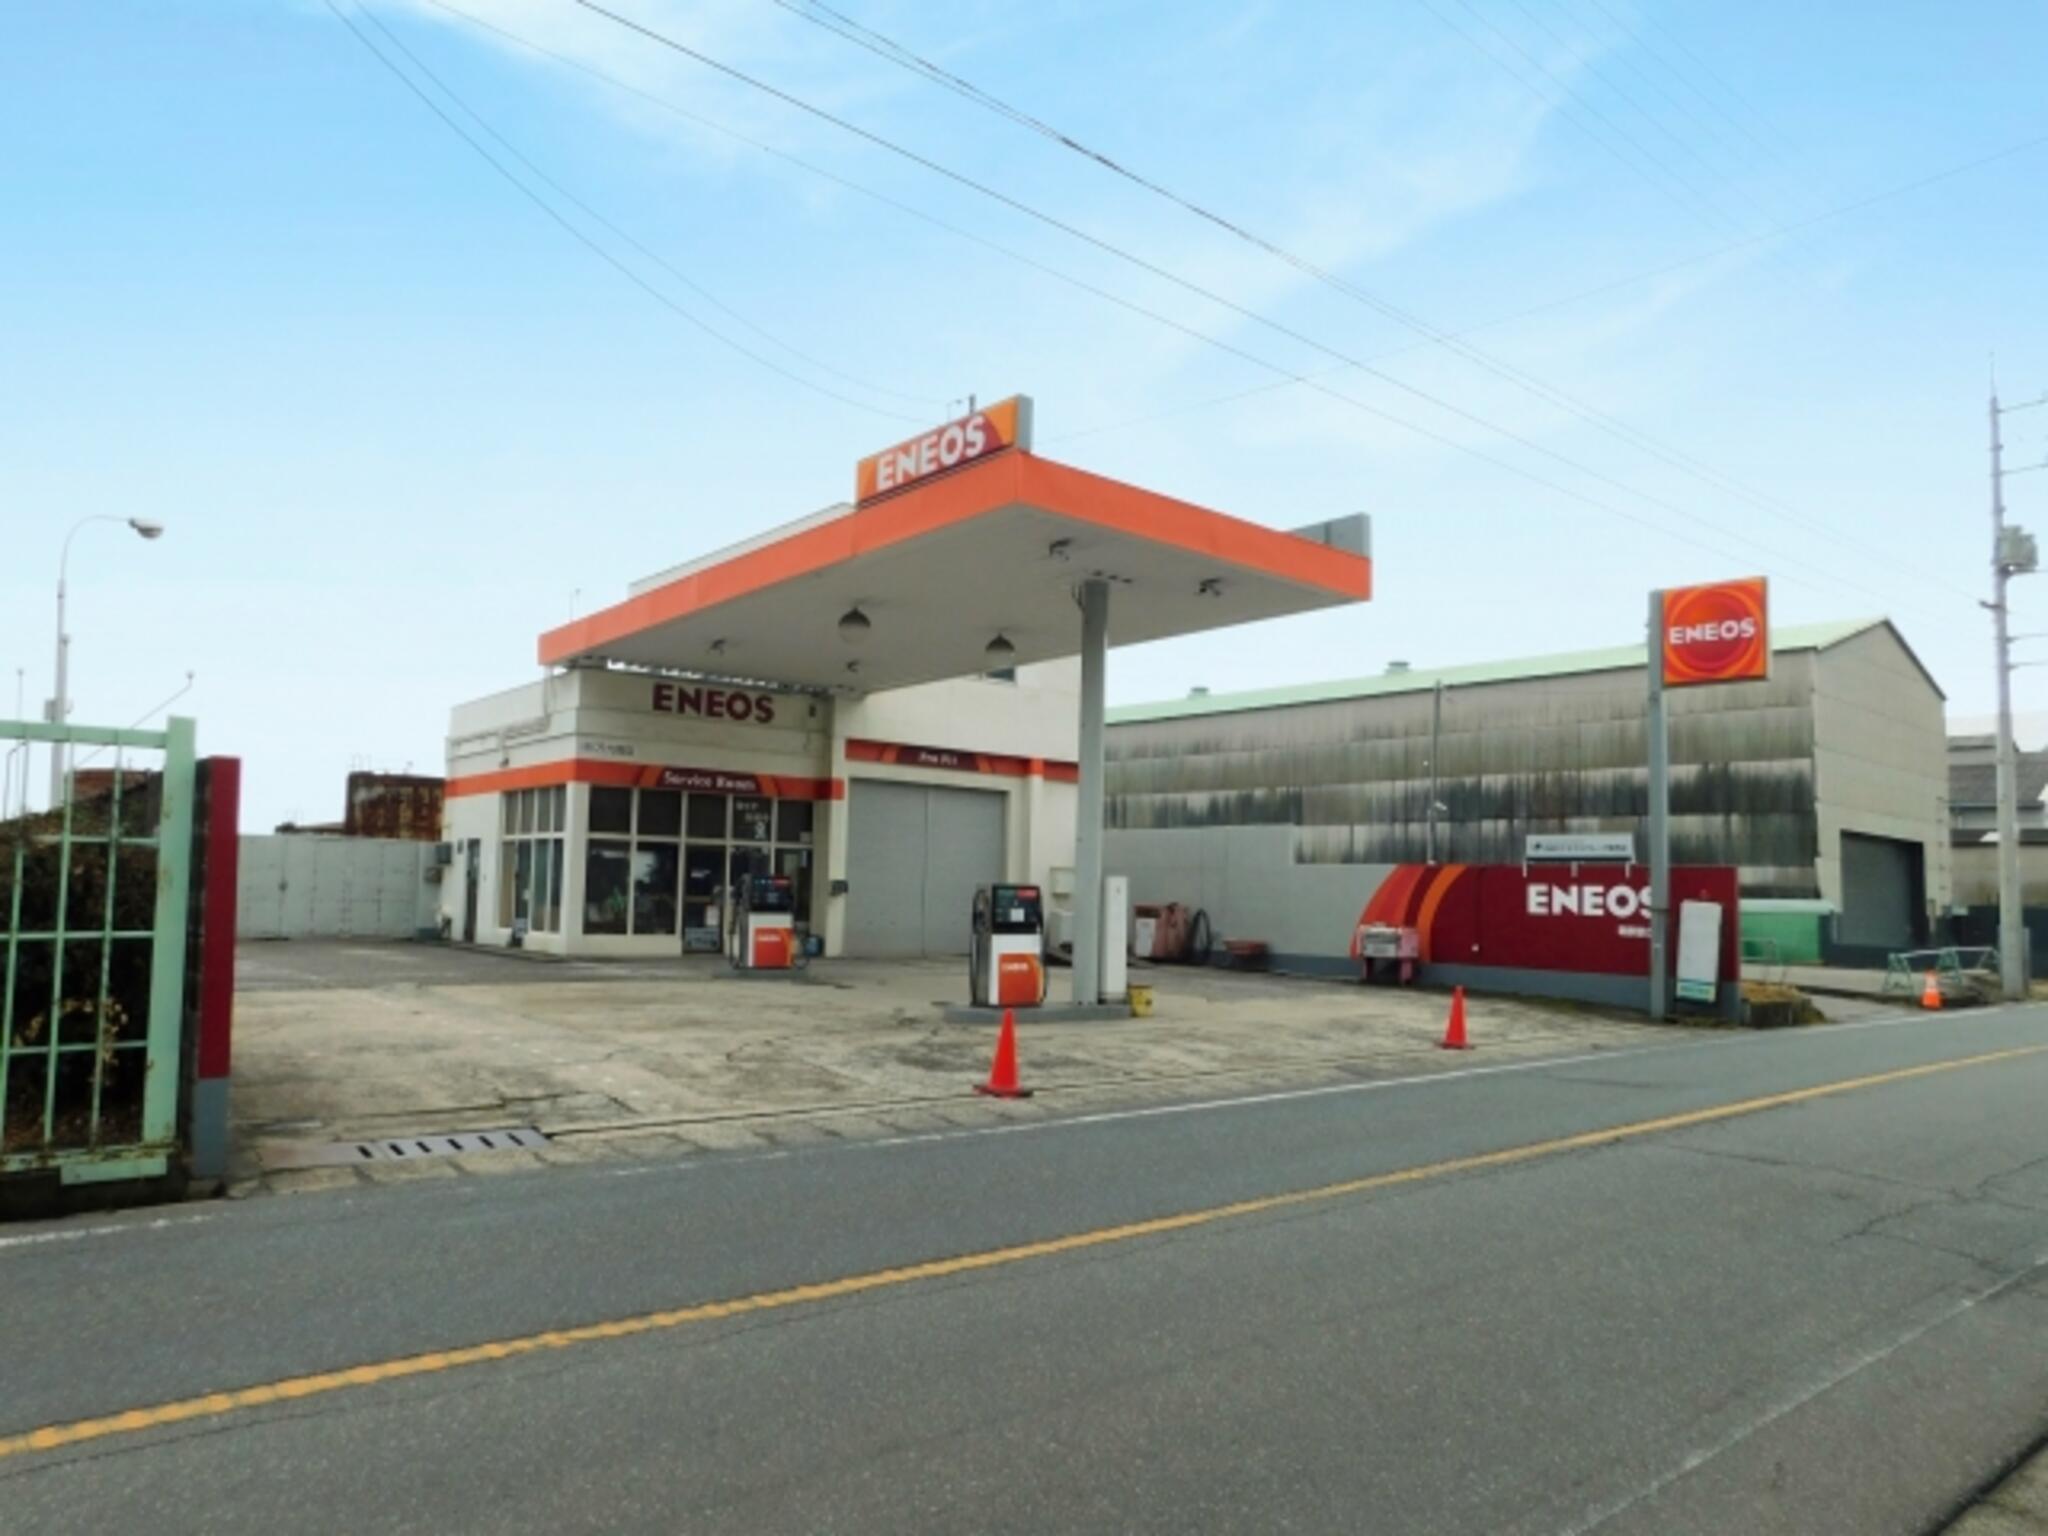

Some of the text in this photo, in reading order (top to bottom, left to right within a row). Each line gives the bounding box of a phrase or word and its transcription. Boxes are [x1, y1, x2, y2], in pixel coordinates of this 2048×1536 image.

[876, 414, 986, 491] ENEOS
[1669, 617, 1755, 644] ENEOS
[652, 682, 775, 723] ENEOS
